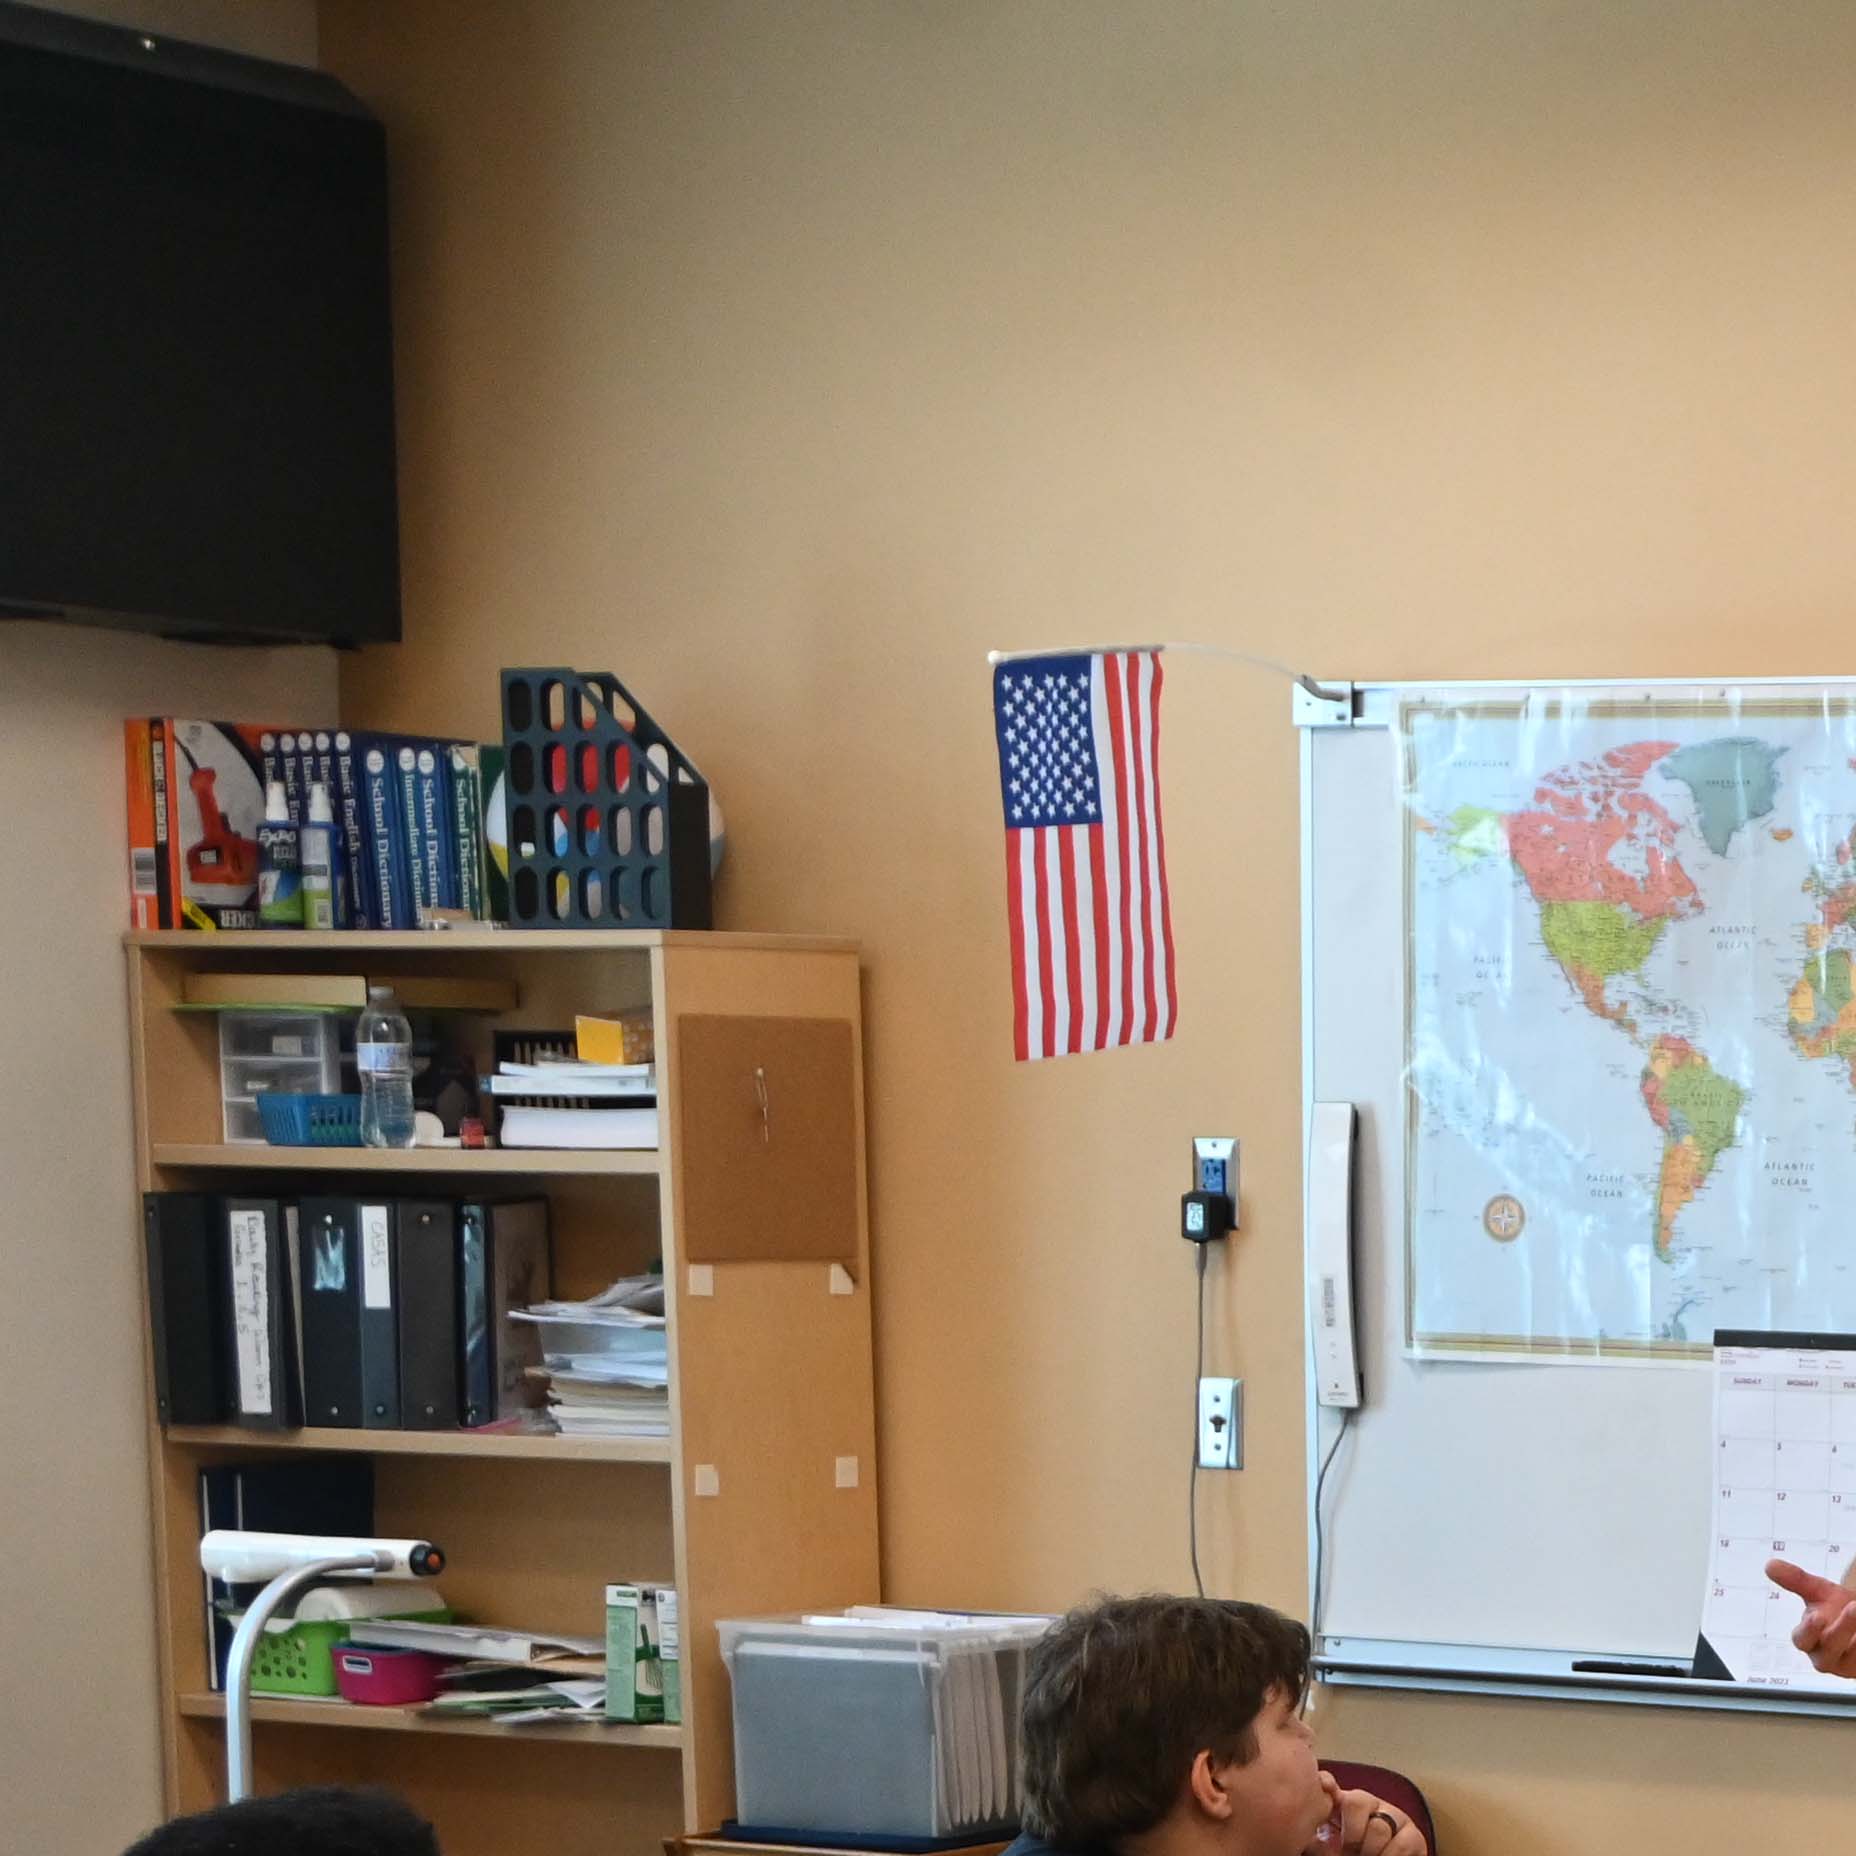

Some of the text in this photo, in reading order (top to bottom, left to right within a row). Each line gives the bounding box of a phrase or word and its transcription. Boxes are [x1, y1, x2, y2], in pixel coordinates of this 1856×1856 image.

[423, 778, 436, 834] School
[371, 777, 393, 928] School Dictionary
[1764, 1162, 1816, 1171] ATLANTIC
[1722, 1489, 1732, 1498] 11
